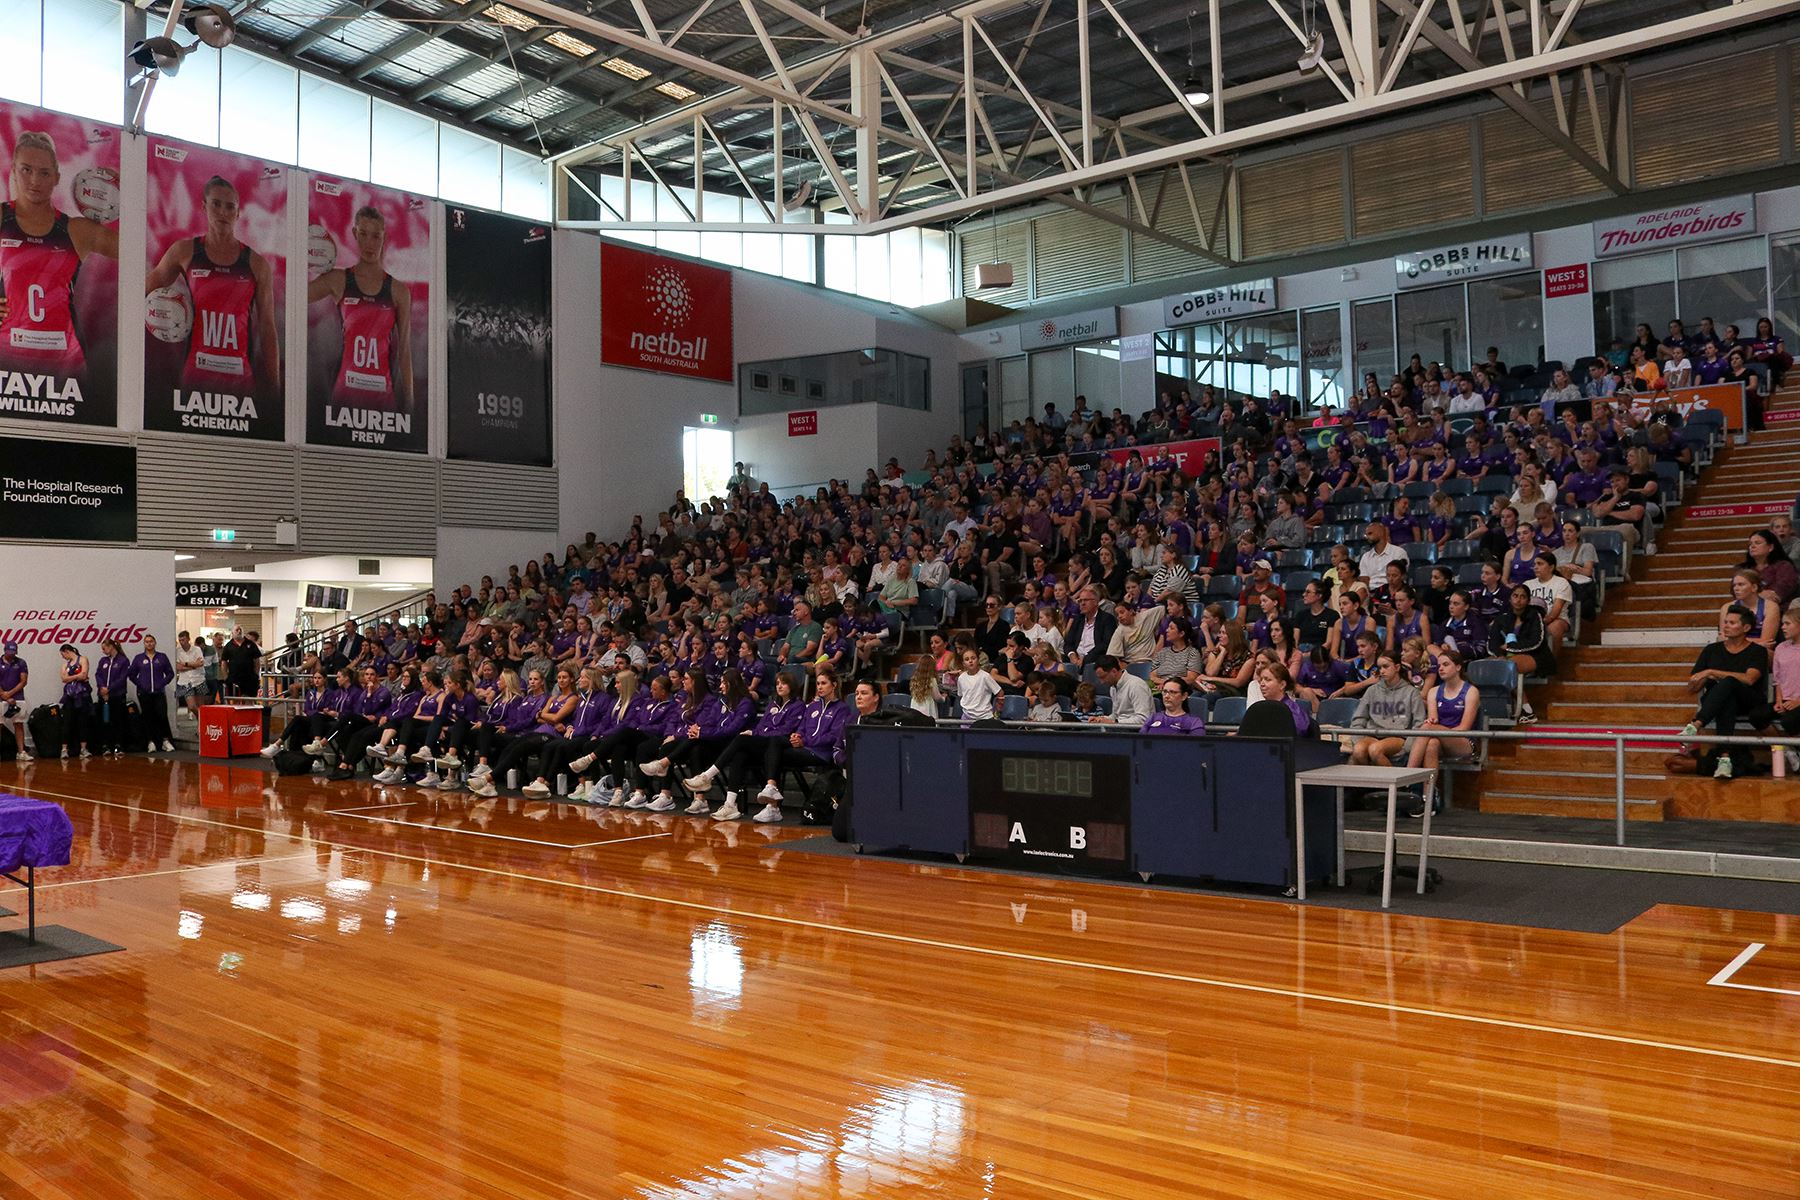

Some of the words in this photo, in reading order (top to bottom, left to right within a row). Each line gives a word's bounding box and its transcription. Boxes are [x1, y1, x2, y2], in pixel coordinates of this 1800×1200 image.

[1636, 207, 1702, 225] ADELAIDE
[1600, 210, 1746, 252] Thunderbirds
[1476, 245, 1521, 262] HILL
[1447, 266, 1479, 277] SUITE
[1548, 271, 1576, 283] WEST
[1578, 269, 1585, 279] 3
[28, 284, 45, 322] C
[1230, 289, 1266, 304] HILL
[1205, 307, 1232, 317] SUITE
[202, 309, 238, 350] WA
[1059, 321, 1098, 338] netball
[353, 335, 379, 370] GA
[631, 331, 708, 361] netball
[640, 353, 663, 364] SOUTH
[663, 357, 699, 370] AUSTRALIA
[0, 396, 75, 416] WILLIAMS
[173, 388, 258, 419] LAURA
[478, 392, 523, 418] 1999
[181, 413, 249, 432] SCHERIAN
[325, 405, 411, 434] LAUREN
[791, 416, 809, 425] WEST
[351, 430, 386, 444] FREW
[3, 477, 25, 489] The
[27, 479, 73, 492] Hospital
[75, 481, 123, 495] Research
[3, 491, 67, 504] Foundation
[69, 494, 102, 508] Group
[176, 583, 216, 598] OBBS
[219, 583, 248, 600] HILL
[190, 597, 227, 605] ESTATE
[13, 610, 98, 620] ADELAIDE
[0, 623, 148, 645] underbirds
[231, 724, 260, 736] Nippy's
[1008, 822, 1027, 844] A
[1070, 826, 1087, 849] B
